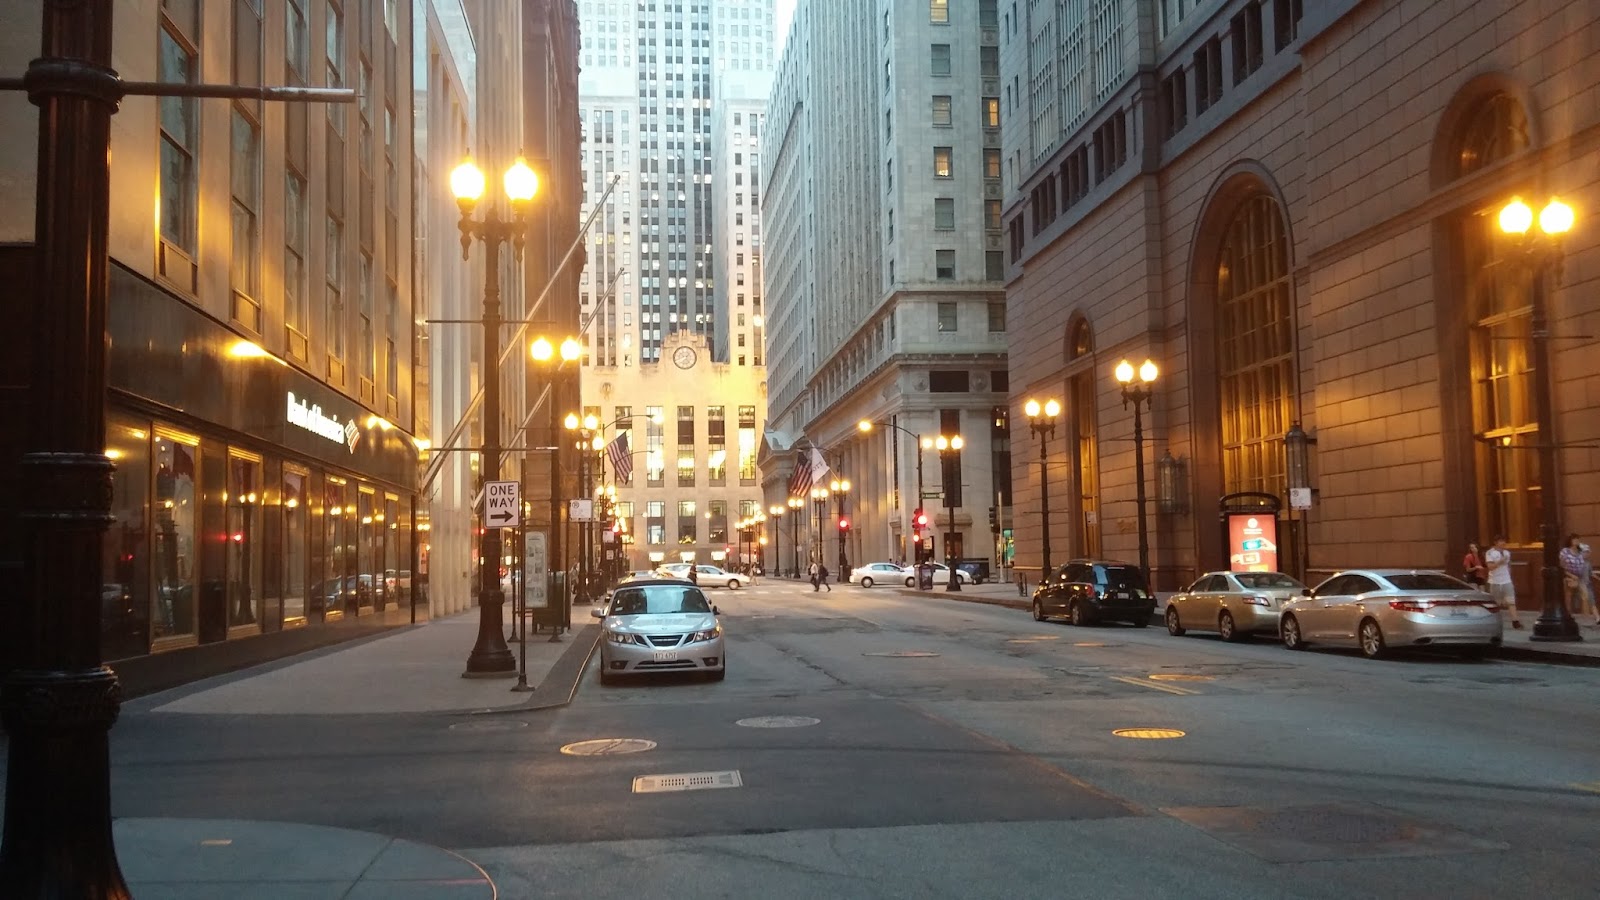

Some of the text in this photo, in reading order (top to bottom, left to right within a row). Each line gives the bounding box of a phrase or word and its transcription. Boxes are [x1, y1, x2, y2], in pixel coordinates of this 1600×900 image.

[287, 391, 308, 429] Bk
[490, 485, 514, 496] ONE
[489, 497, 515, 508] WAY
